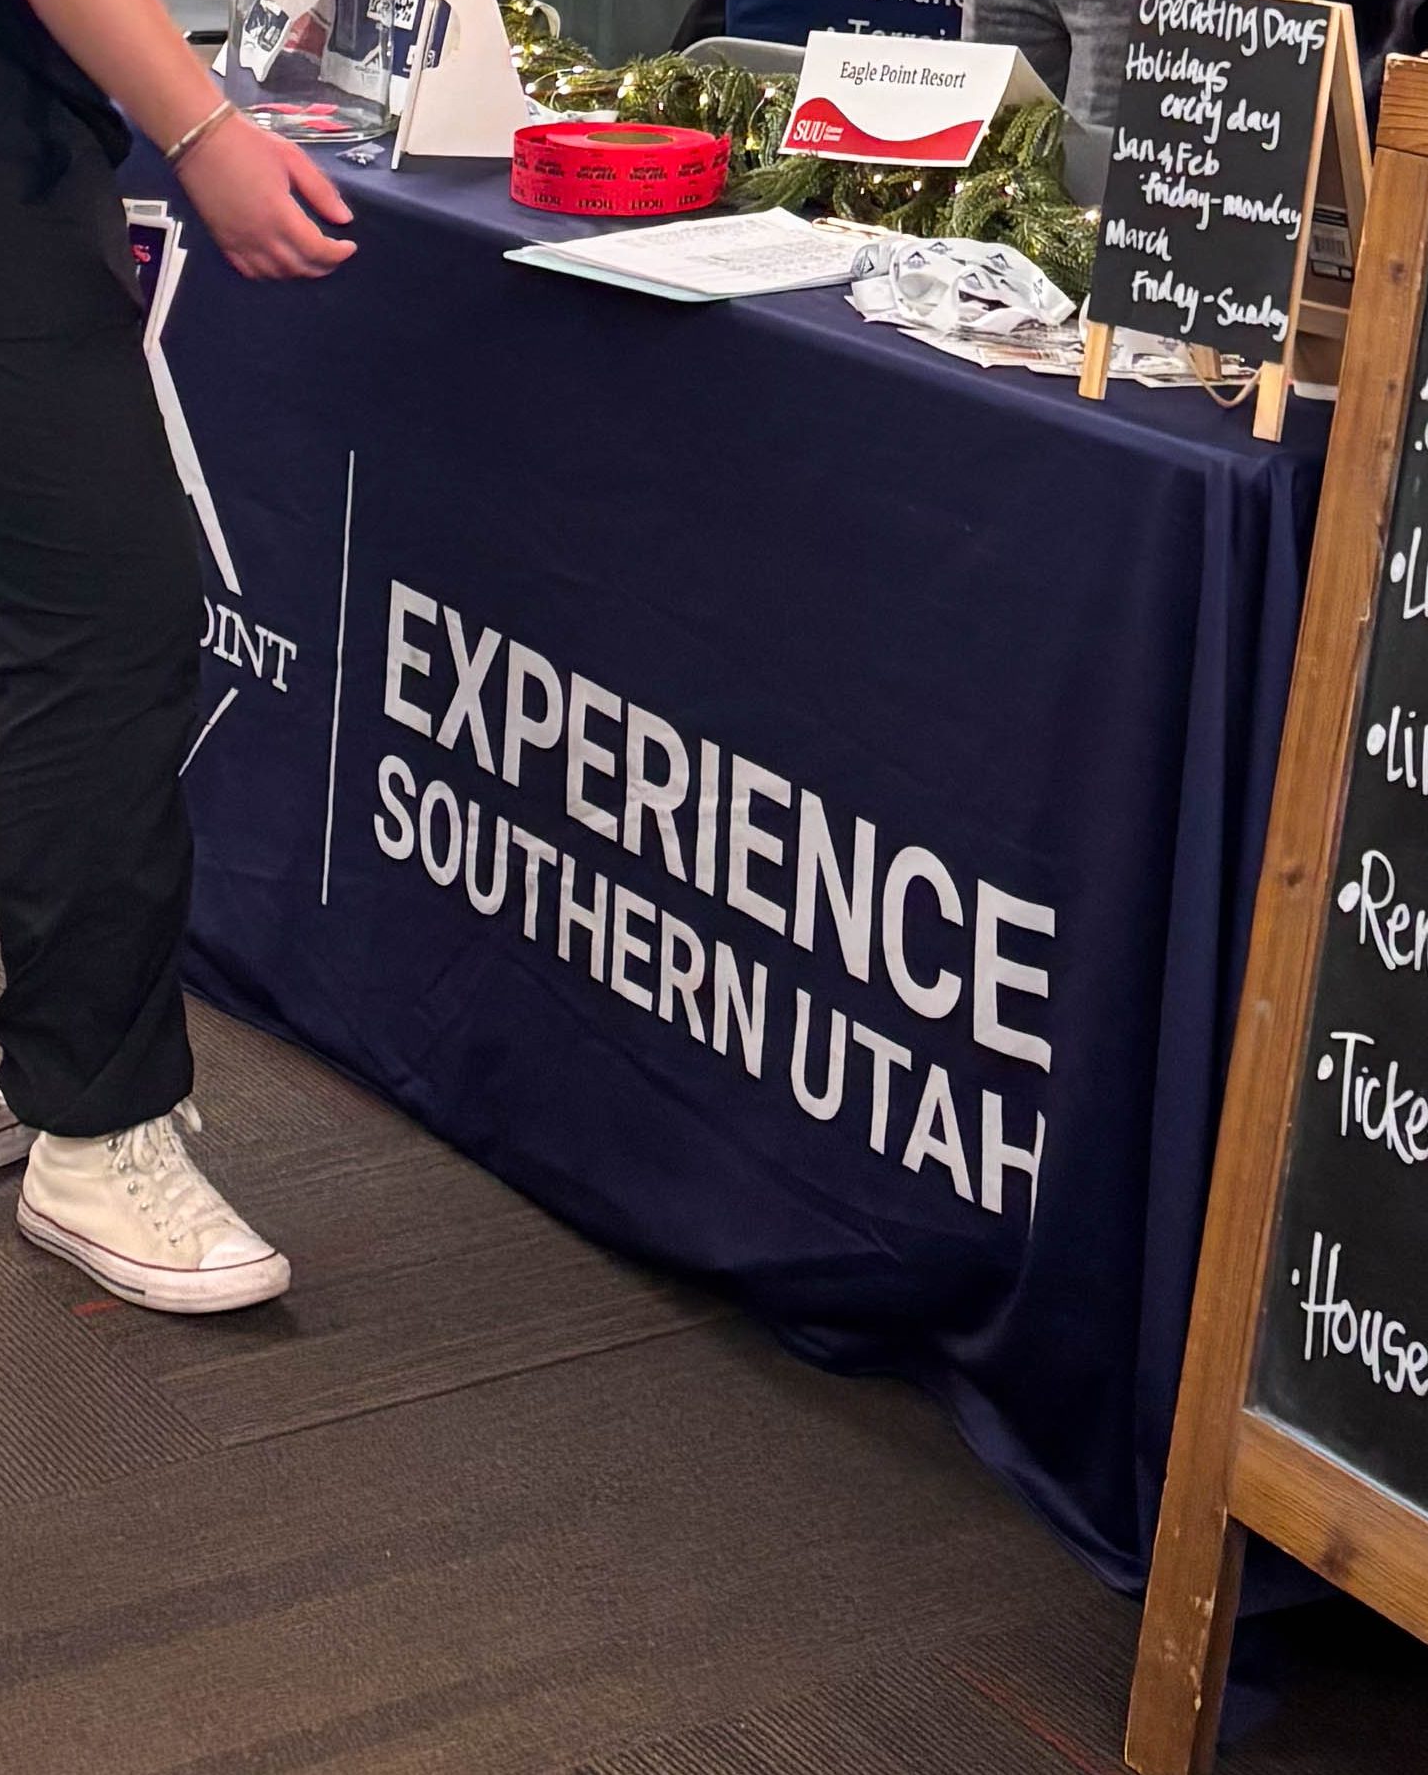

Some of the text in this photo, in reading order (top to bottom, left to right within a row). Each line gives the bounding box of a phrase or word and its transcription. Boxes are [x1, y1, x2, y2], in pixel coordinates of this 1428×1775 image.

[1263, 3, 1327, 64] Days
[840, 61, 966, 88] Eagle Point Resort
[1125, 42, 1231, 100] Holidays
[793, 119, 827, 143] SUU
[1161, 94, 1281, 151] every day
[1113, 127, 1155, 161] Jan
[1176, 142, 1221, 176] Feb
[1105, 218, 1172, 261] March
[383, 579, 1058, 1075] EXPERIENCE
[372, 753, 1046, 1240] SOUTHERN UTAH
